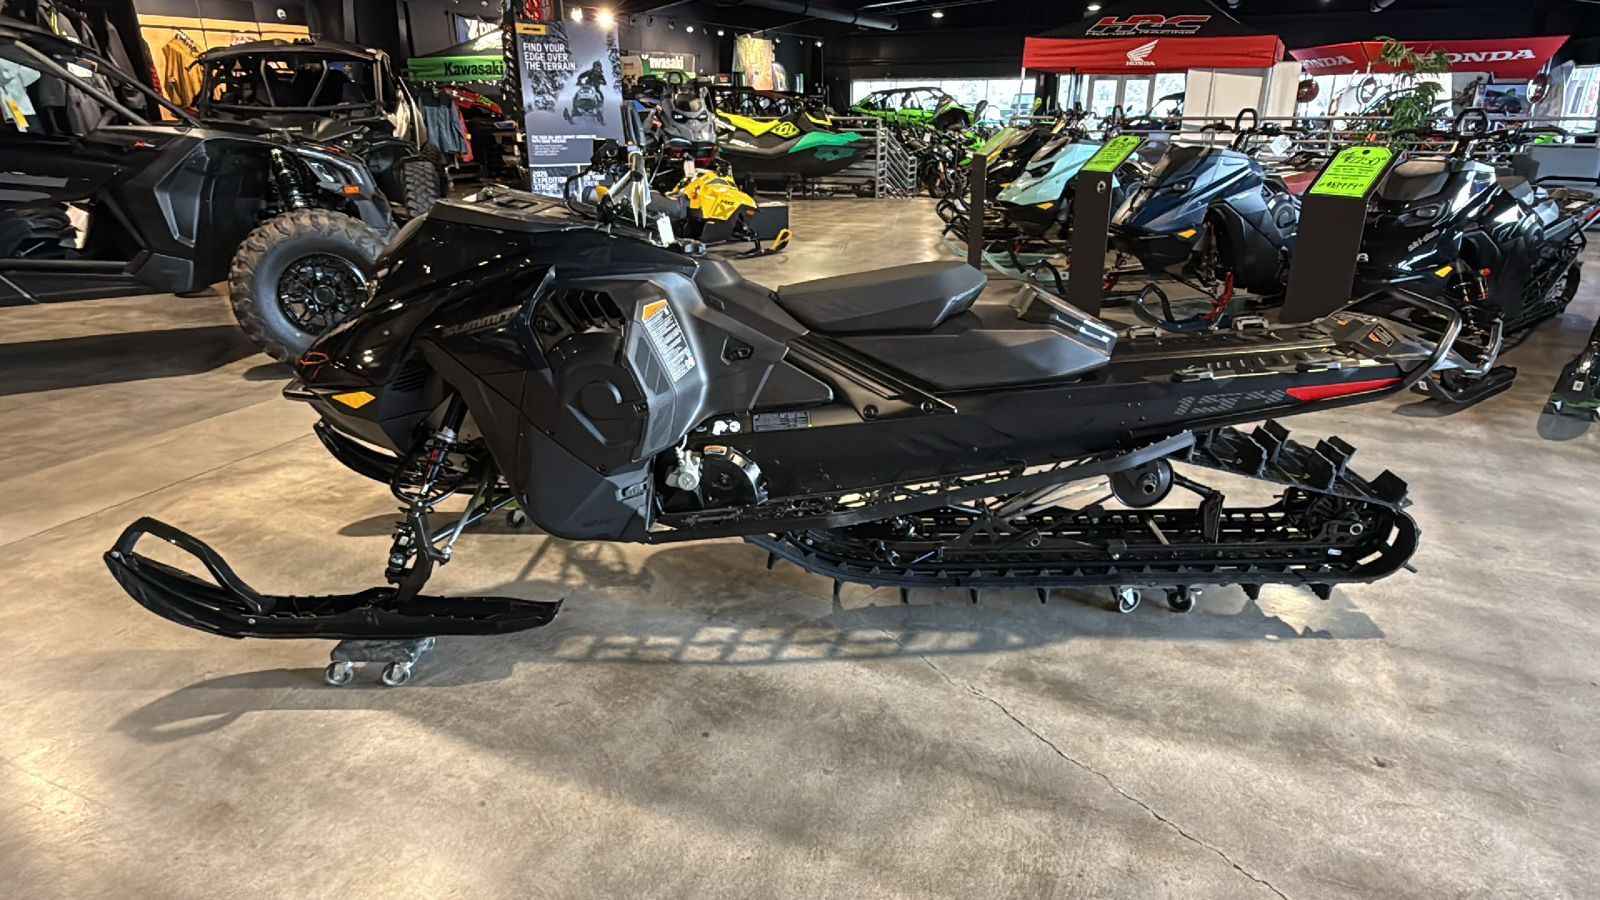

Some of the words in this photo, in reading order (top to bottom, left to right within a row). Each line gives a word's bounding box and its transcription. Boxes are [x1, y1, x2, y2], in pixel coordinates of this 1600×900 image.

[523, 42, 542, 53] FIND
[543, 43, 566, 53] YOUR
[524, 51, 545, 61] EDGE
[547, 53, 569, 61] OVER
[444, 60, 504, 76] Kawasaki
[525, 61, 541, 70] THE
